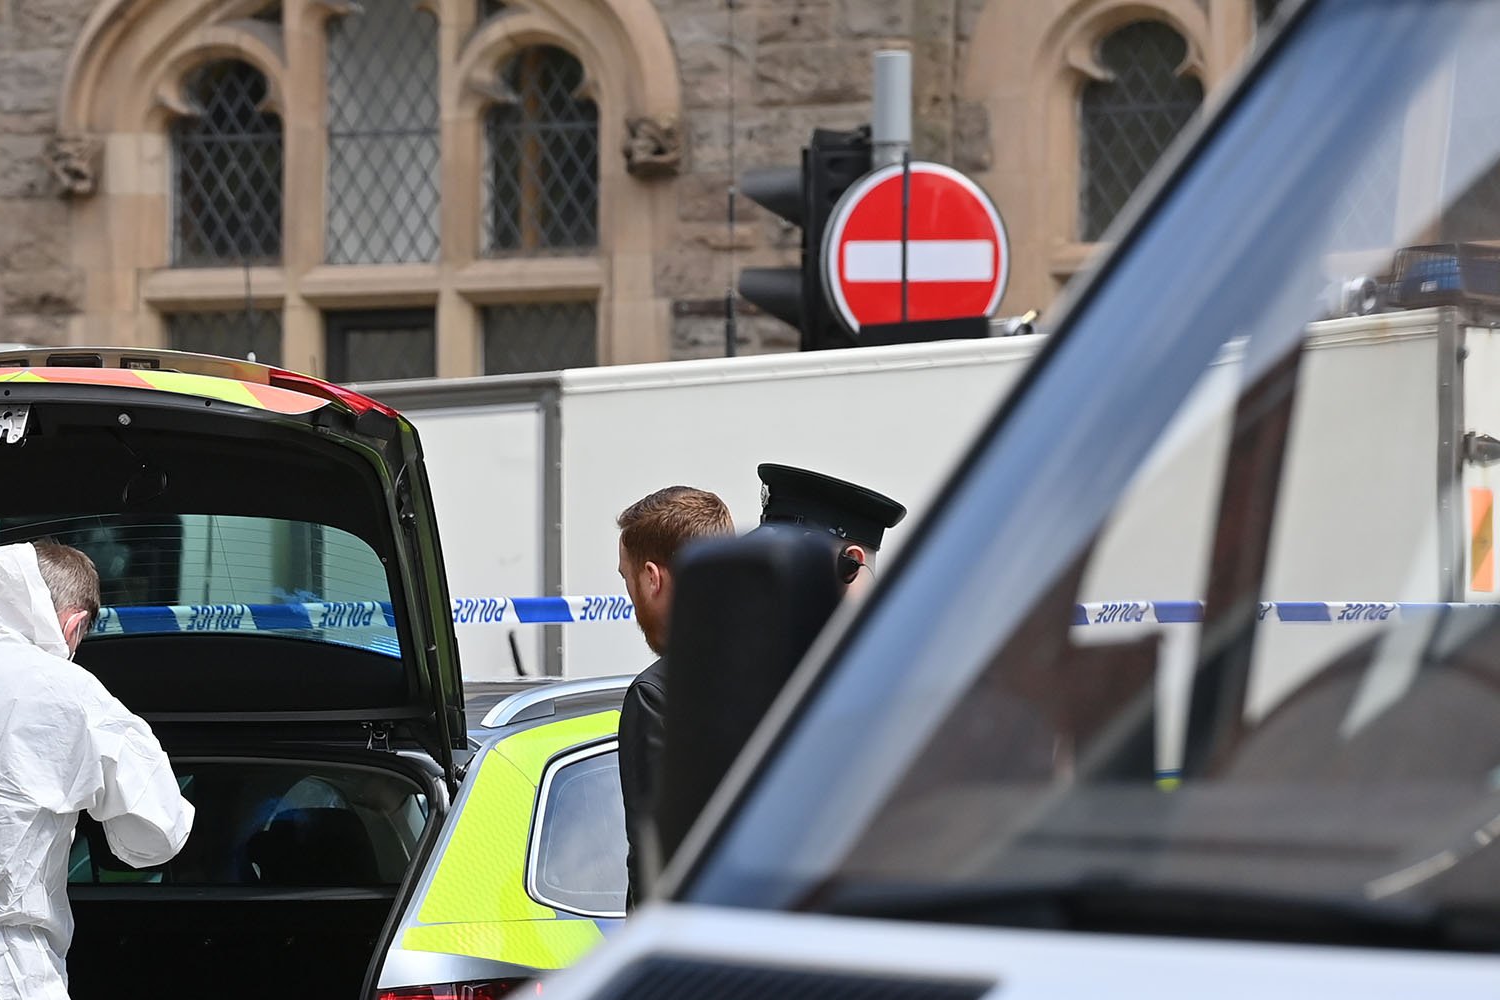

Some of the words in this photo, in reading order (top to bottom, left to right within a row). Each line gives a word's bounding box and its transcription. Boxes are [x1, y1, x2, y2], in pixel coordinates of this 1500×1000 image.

[187, 604, 244, 631] POLICE
[318, 602, 376, 628] POLICE
[1094, 602, 1150, 623] POLICE
[1337, 603, 1396, 620] POLICE
